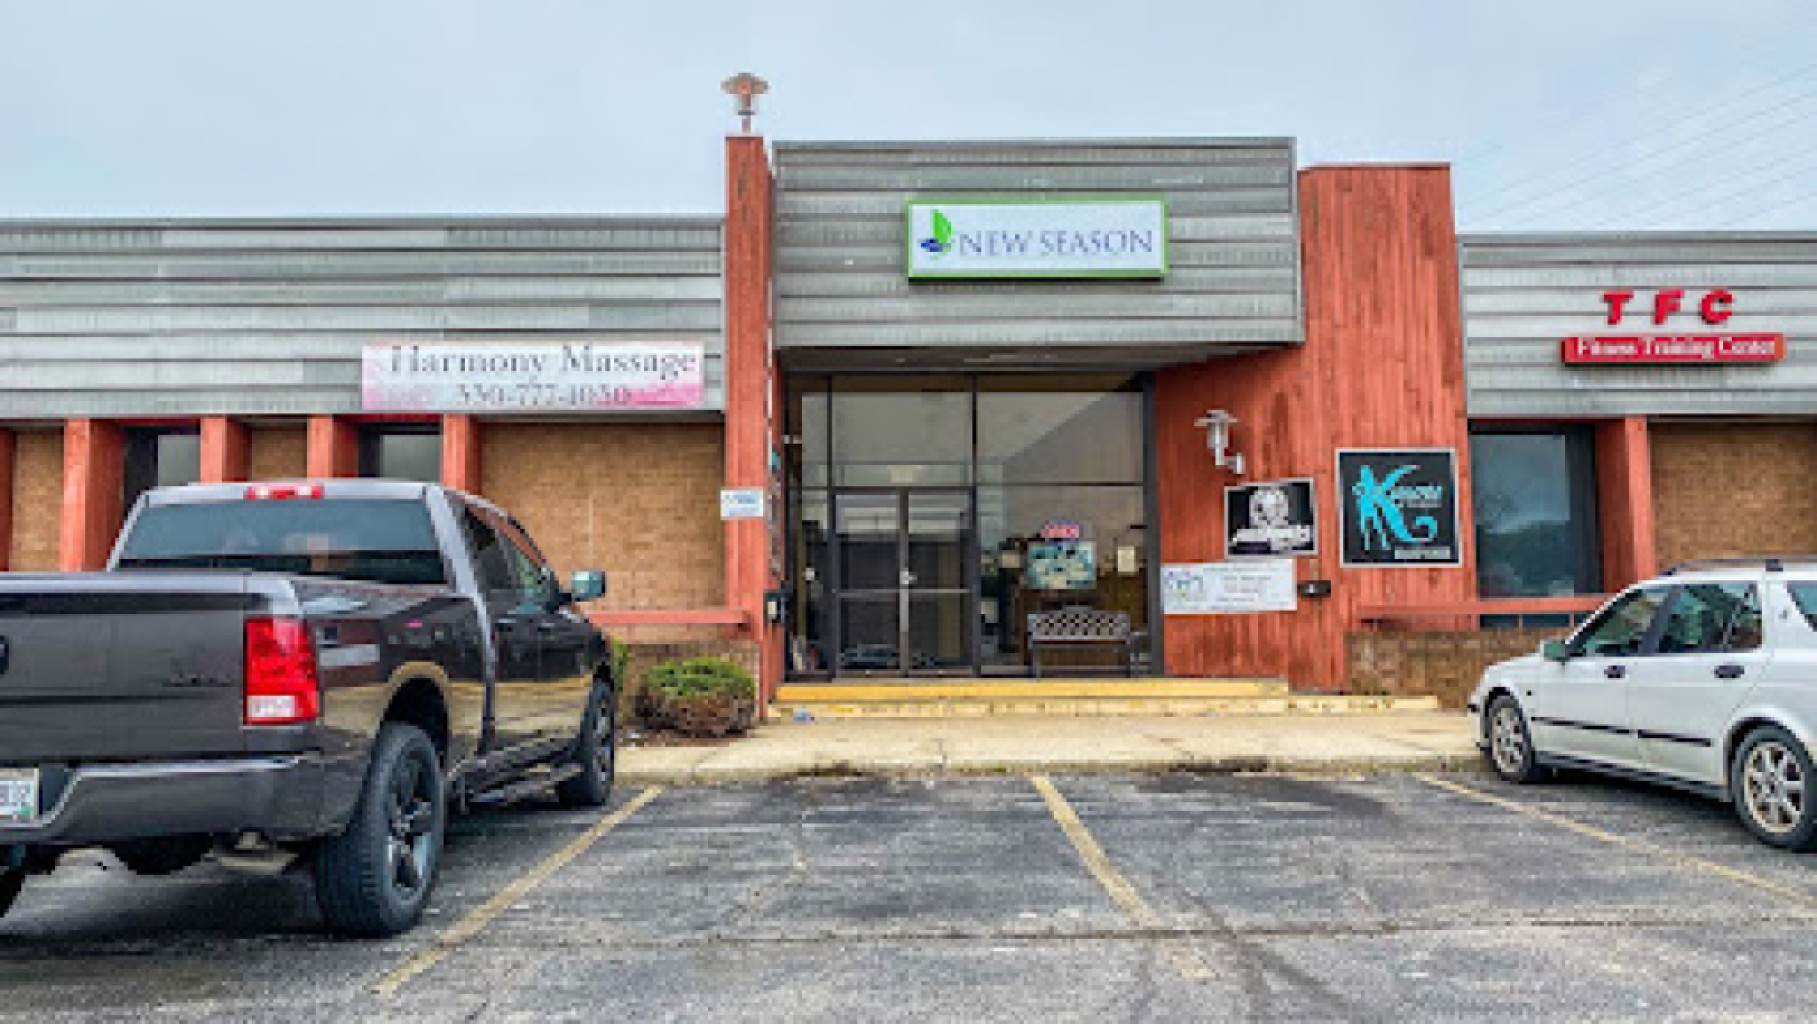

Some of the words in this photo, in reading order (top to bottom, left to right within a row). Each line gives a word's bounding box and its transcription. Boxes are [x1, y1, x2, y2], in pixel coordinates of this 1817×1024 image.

[958, 229, 1033, 256] NEW
[1039, 229, 1152, 256] SEASON
[1576, 335, 1639, 356] Fitness
[1643, 335, 1714, 359] Training
[1719, 335, 1776, 356] Center
[390, 343, 548, 382] Harmony
[562, 343, 698, 382] Massage
